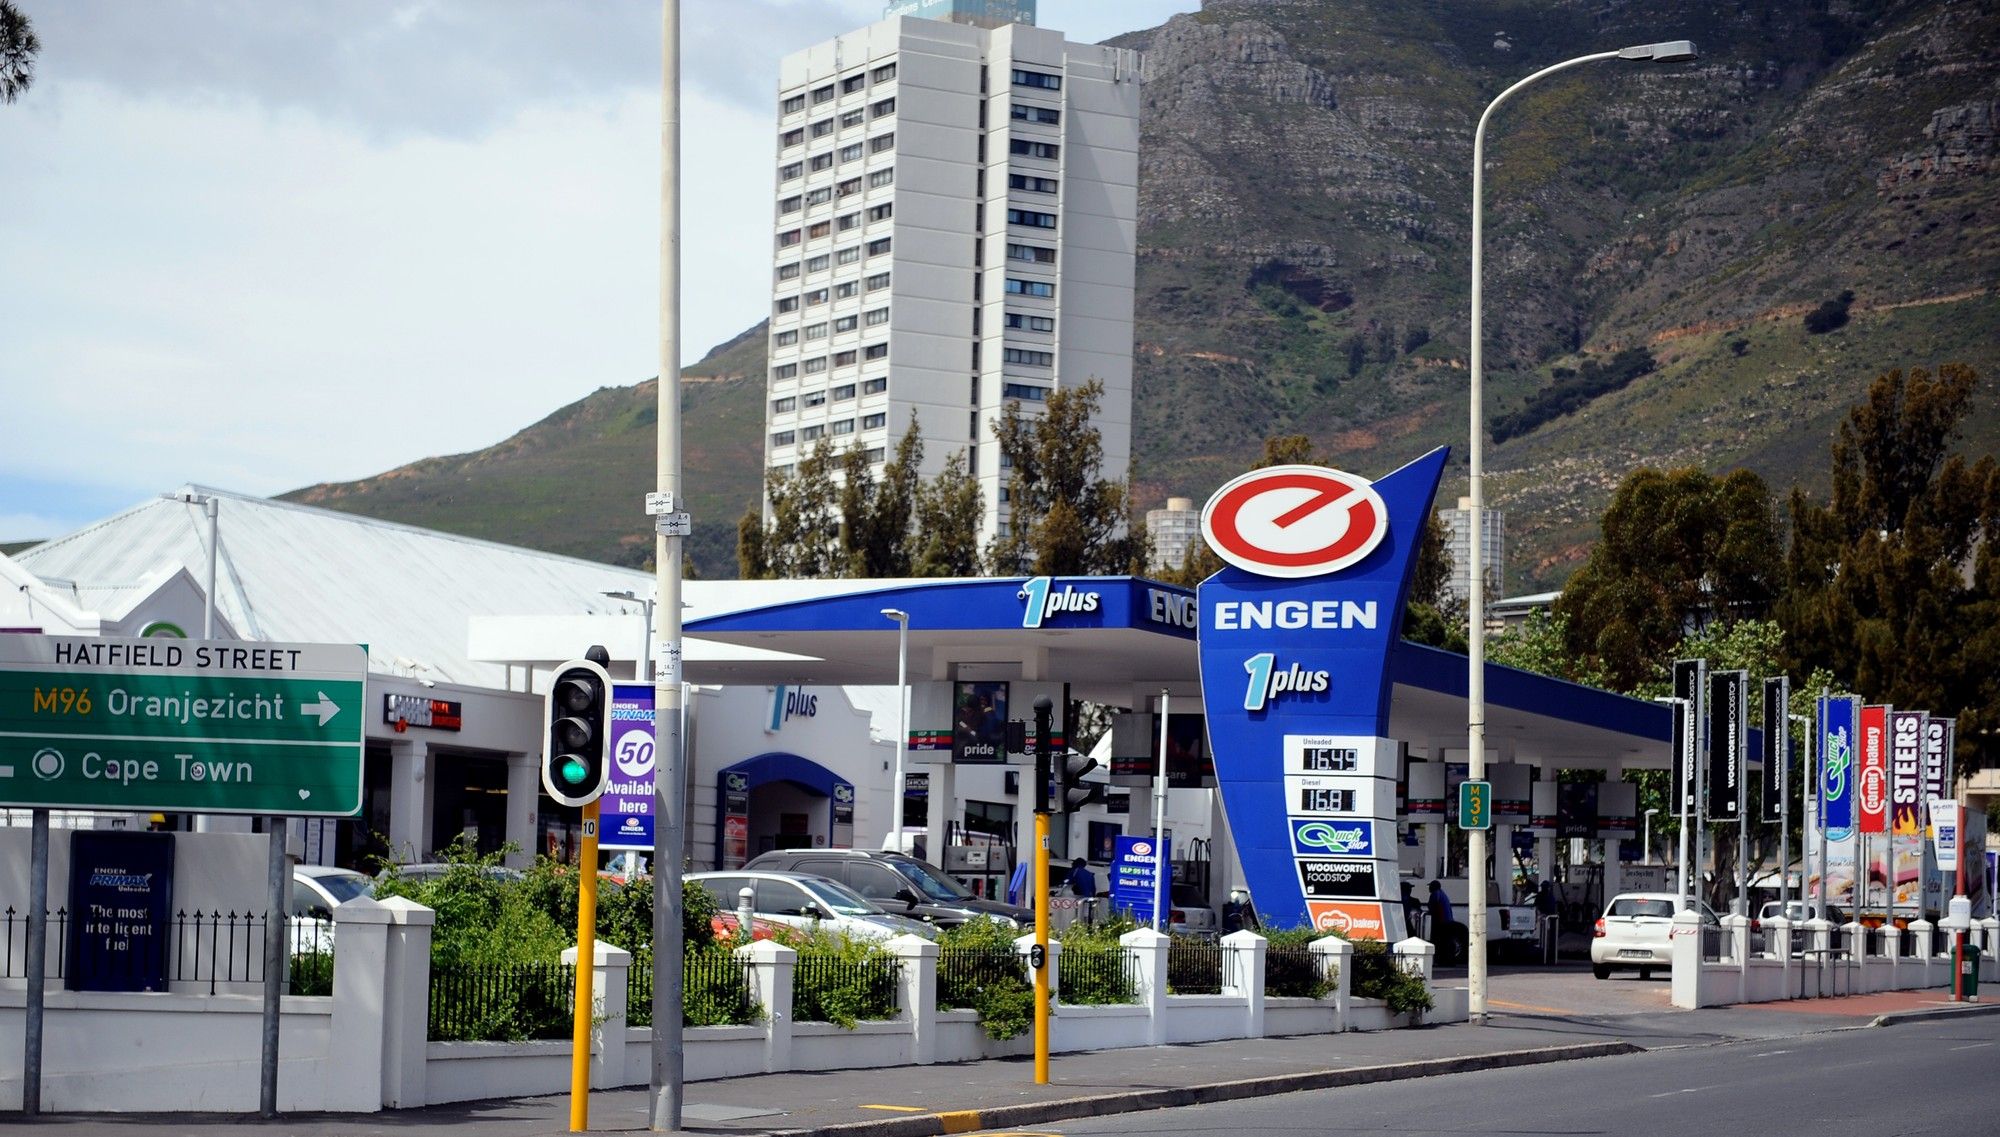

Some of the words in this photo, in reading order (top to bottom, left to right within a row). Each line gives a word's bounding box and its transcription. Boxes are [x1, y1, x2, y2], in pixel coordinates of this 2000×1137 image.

[1023, 577, 1100, 628] 1plus
[1149, 588, 1197, 628] ENG
[1215, 601, 1377, 629] ENGEN
[55, 643, 182, 667] HATFIELD
[196, 647, 302, 671] STREET
[1244, 653, 1329, 710] 1plus
[33, 687, 92, 715] M96
[108, 688, 284, 725] Oranjezicht
[611, 709, 656, 721] DYNAM
[1303, 738, 1332, 746] Unleaded
[619, 742, 654, 765] 50
[964, 744, 995, 756] pride
[1728, 723, 1736, 788] WOOLWORTHS
[1311, 749, 1358, 771] 16.49
[1893, 717, 1918, 804] STEERS
[82, 752, 159, 786] Cape
[174, 754, 253, 783] Town
[604, 780, 655, 795] Availabl
[1470, 785, 1480, 795] M
[619, 799, 648, 813] here
[1310, 790, 1356, 811] 16.81
[1470, 797, 1481, 815] 3
[583, 821, 595, 834] 10
[1471, 816, 1479, 826] S
[1347, 841, 1369, 850] SHOP
[1306, 863, 1373, 874] WOOLWORTHS
[89, 873, 152, 887] PRIMAX
[1307, 873, 1352, 882] FOODSTOP
[90, 904, 113, 918] The
[1353, 917, 1381, 930] bakery
